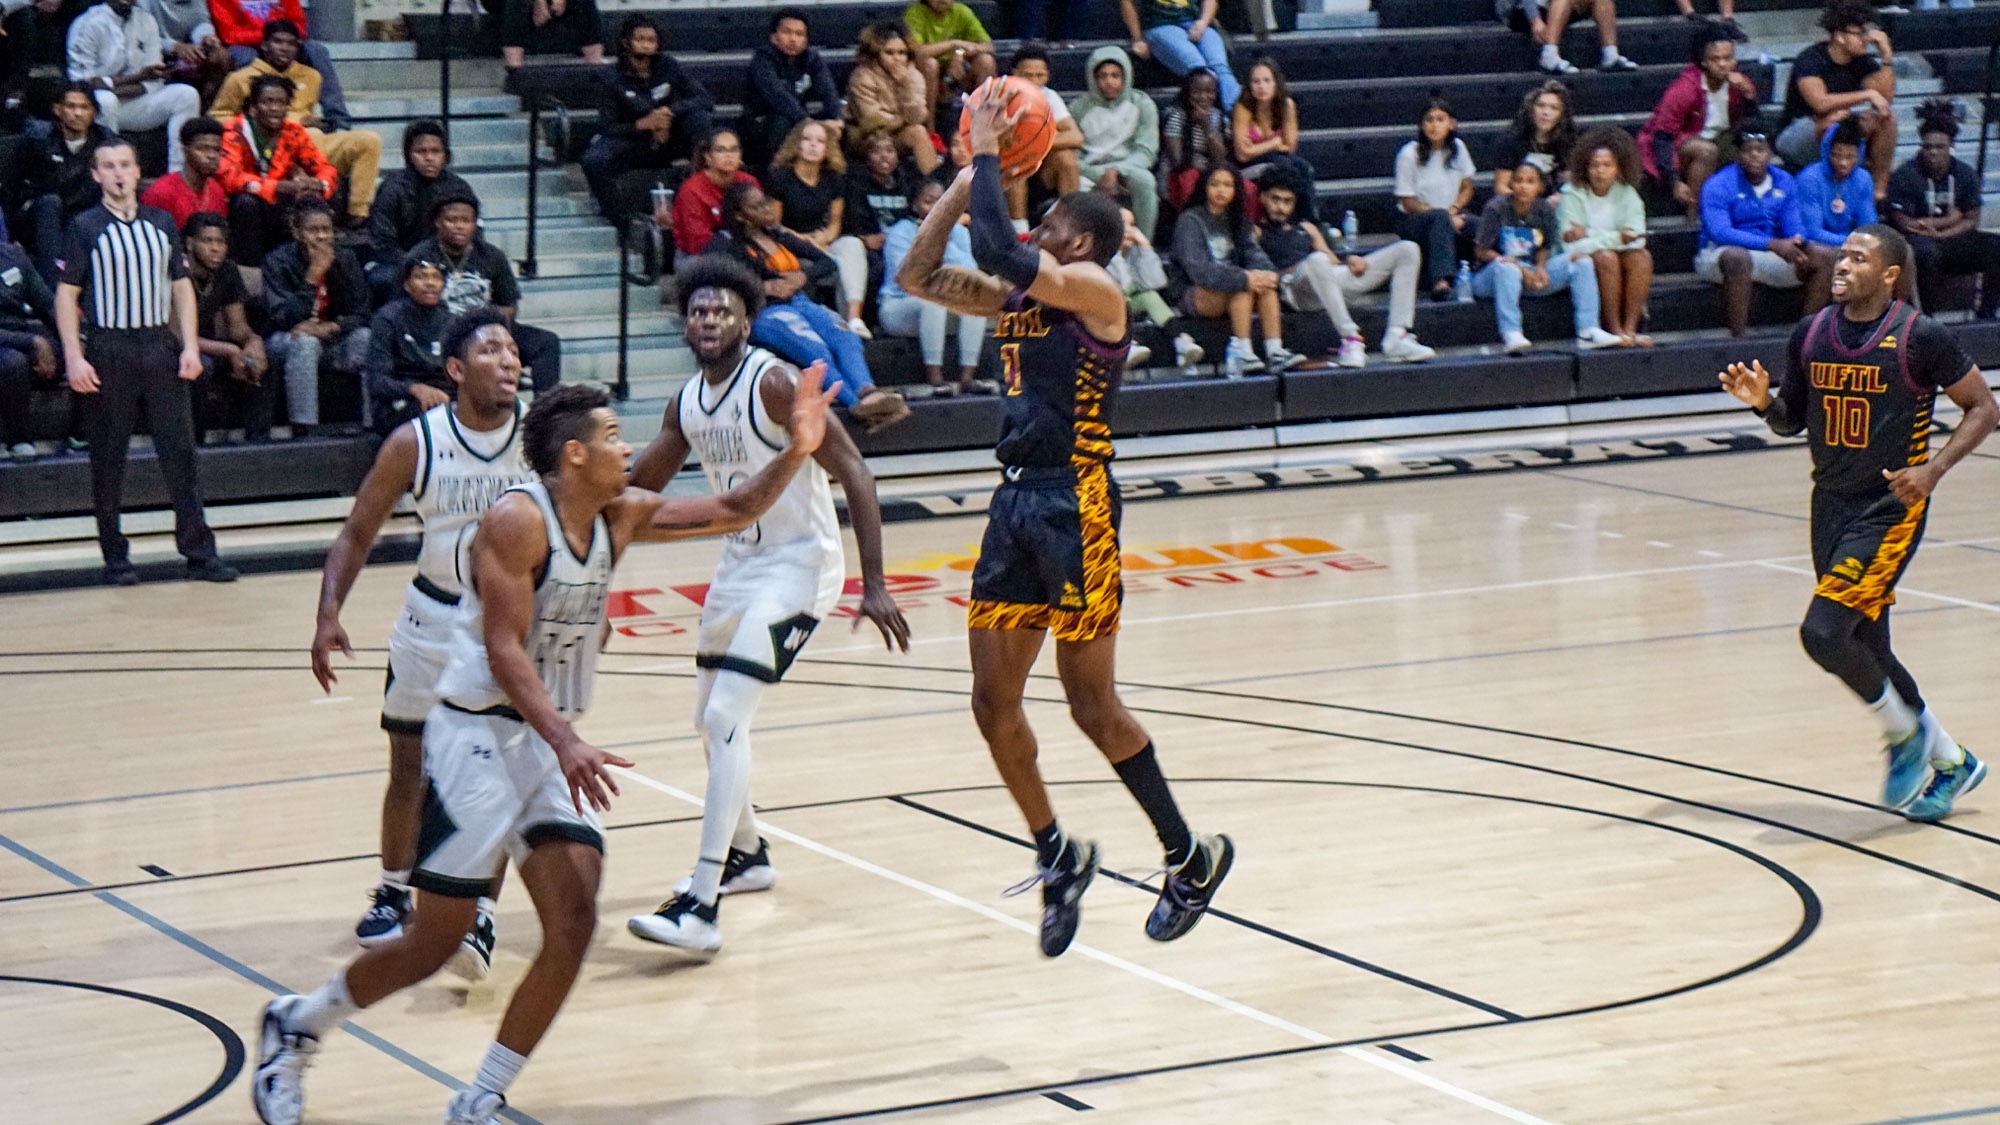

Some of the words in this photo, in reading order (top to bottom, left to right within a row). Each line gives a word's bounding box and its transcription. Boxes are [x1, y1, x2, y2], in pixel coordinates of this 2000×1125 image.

[1000, 343, 1022, 396] 1
[1810, 362, 1888, 393] UFTL
[1823, 395, 1870, 448] 10
